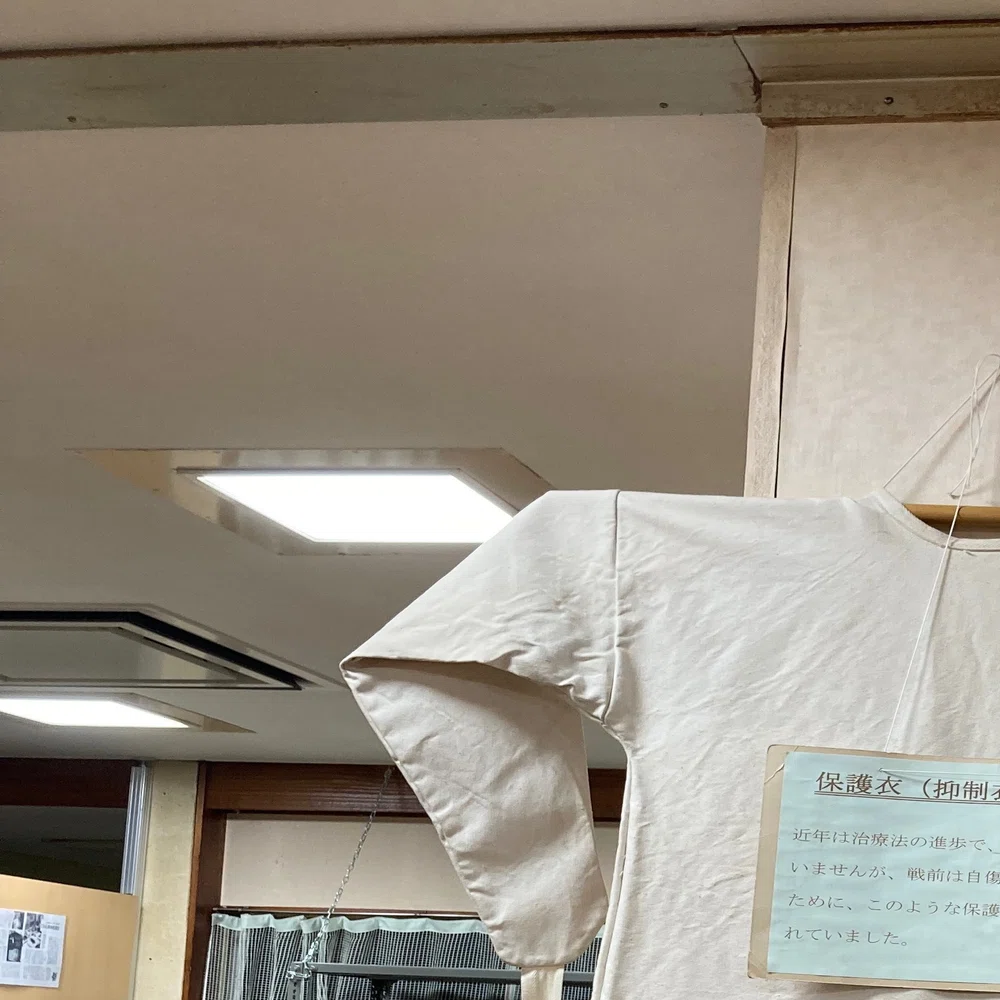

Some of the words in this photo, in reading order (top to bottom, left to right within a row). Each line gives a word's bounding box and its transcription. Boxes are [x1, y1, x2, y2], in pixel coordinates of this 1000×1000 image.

[783, 926, 909, 947] れていました。
